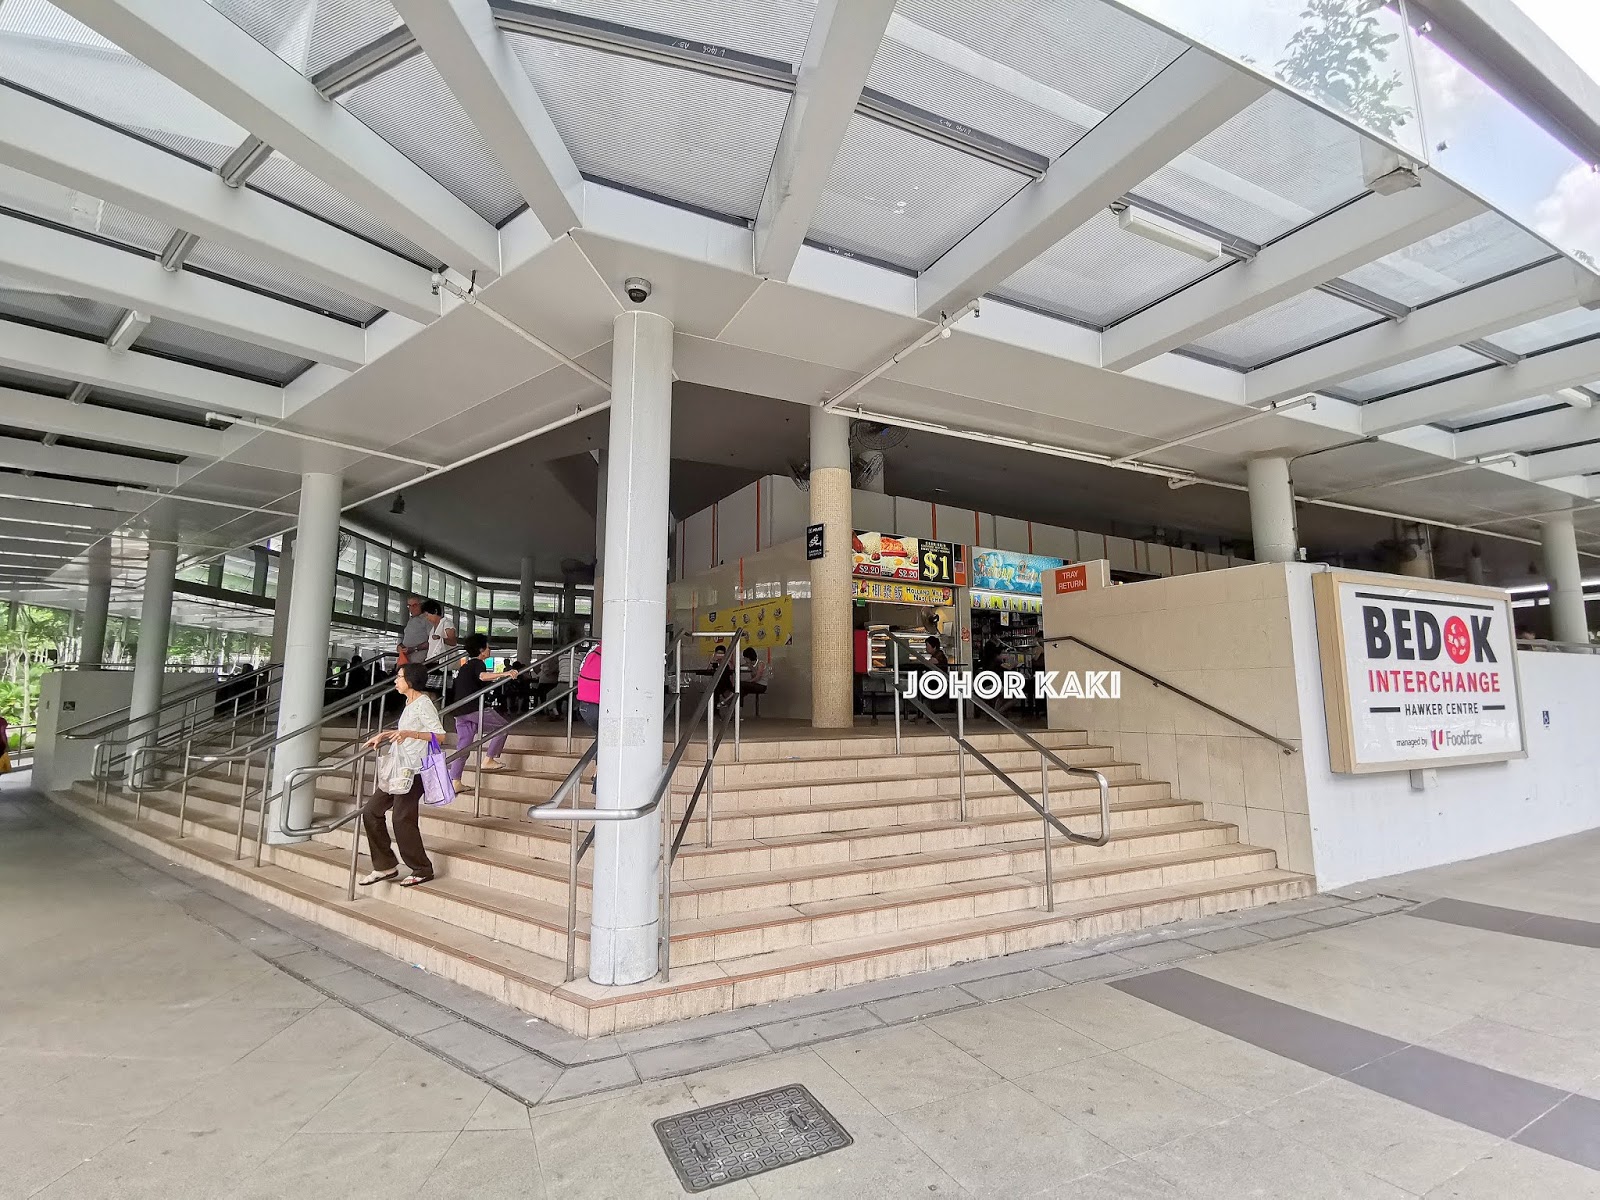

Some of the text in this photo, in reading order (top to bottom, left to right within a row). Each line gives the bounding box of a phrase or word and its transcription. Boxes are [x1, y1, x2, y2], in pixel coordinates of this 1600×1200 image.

[859, 565, 879, 575] $2.20
[898, 568, 918, 579] $2.20
[923, 552, 950, 581] $1
[1062, 570, 1079, 580] TRAY
[1058, 580, 1084, 590] RETURN
[1363, 605, 1498, 664] BEDOK
[1368, 669, 1501, 693] INTERCHANGE
[1404, 702, 1479, 716] HAWKER CENTRE
[1396, 737, 1420, 748] managed
[1421, 737, 1428, 747] by
[1446, 730, 1483, 747] Foodfare
